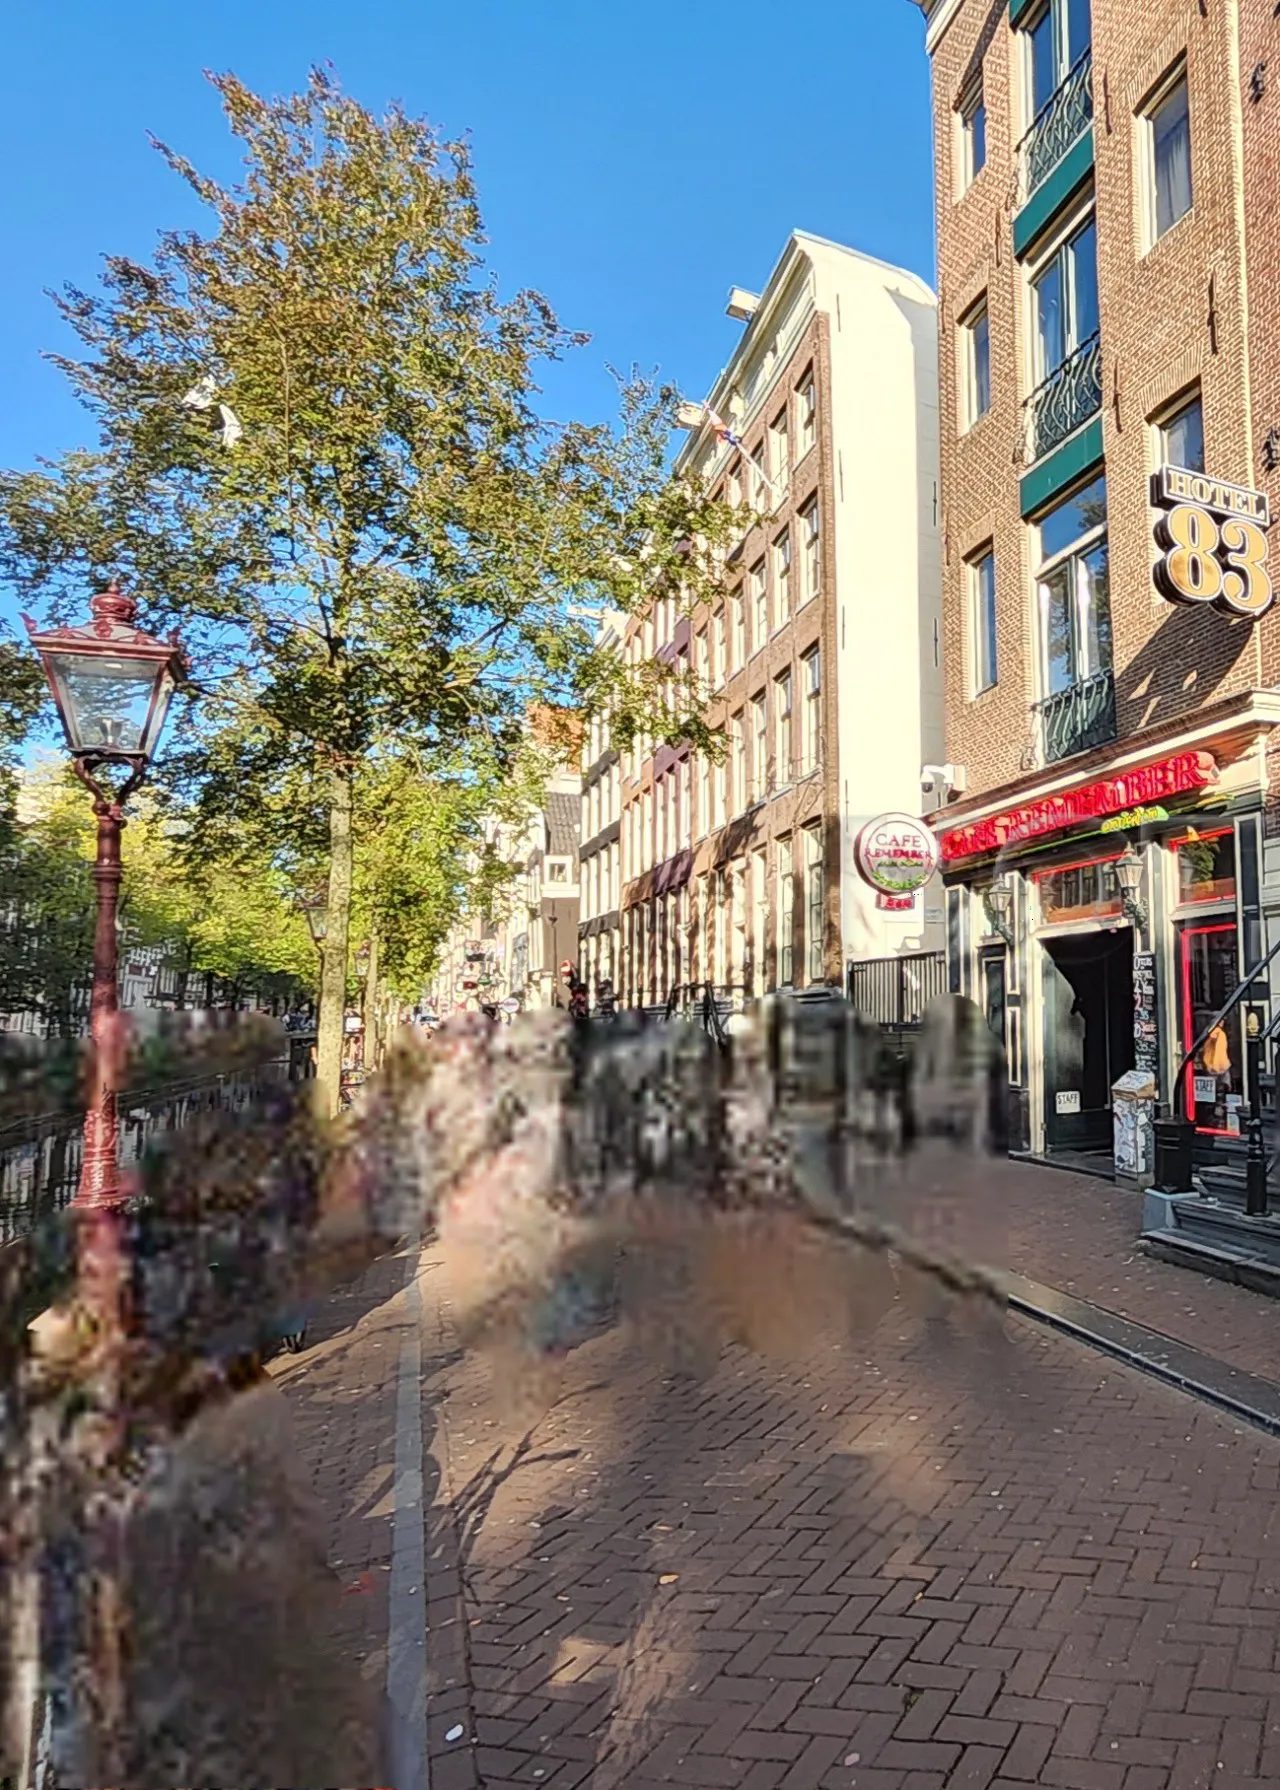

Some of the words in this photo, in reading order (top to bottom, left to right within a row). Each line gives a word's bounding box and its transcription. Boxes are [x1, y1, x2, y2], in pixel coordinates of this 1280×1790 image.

[1168, 470, 1266, 520] HOTEL
[1167, 504, 1272, 612] 83
[876, 833, 921, 847] CAFE
[1195, 1078, 1213, 1092] STAFF
[1057, 1093, 1078, 1105] STAFF
